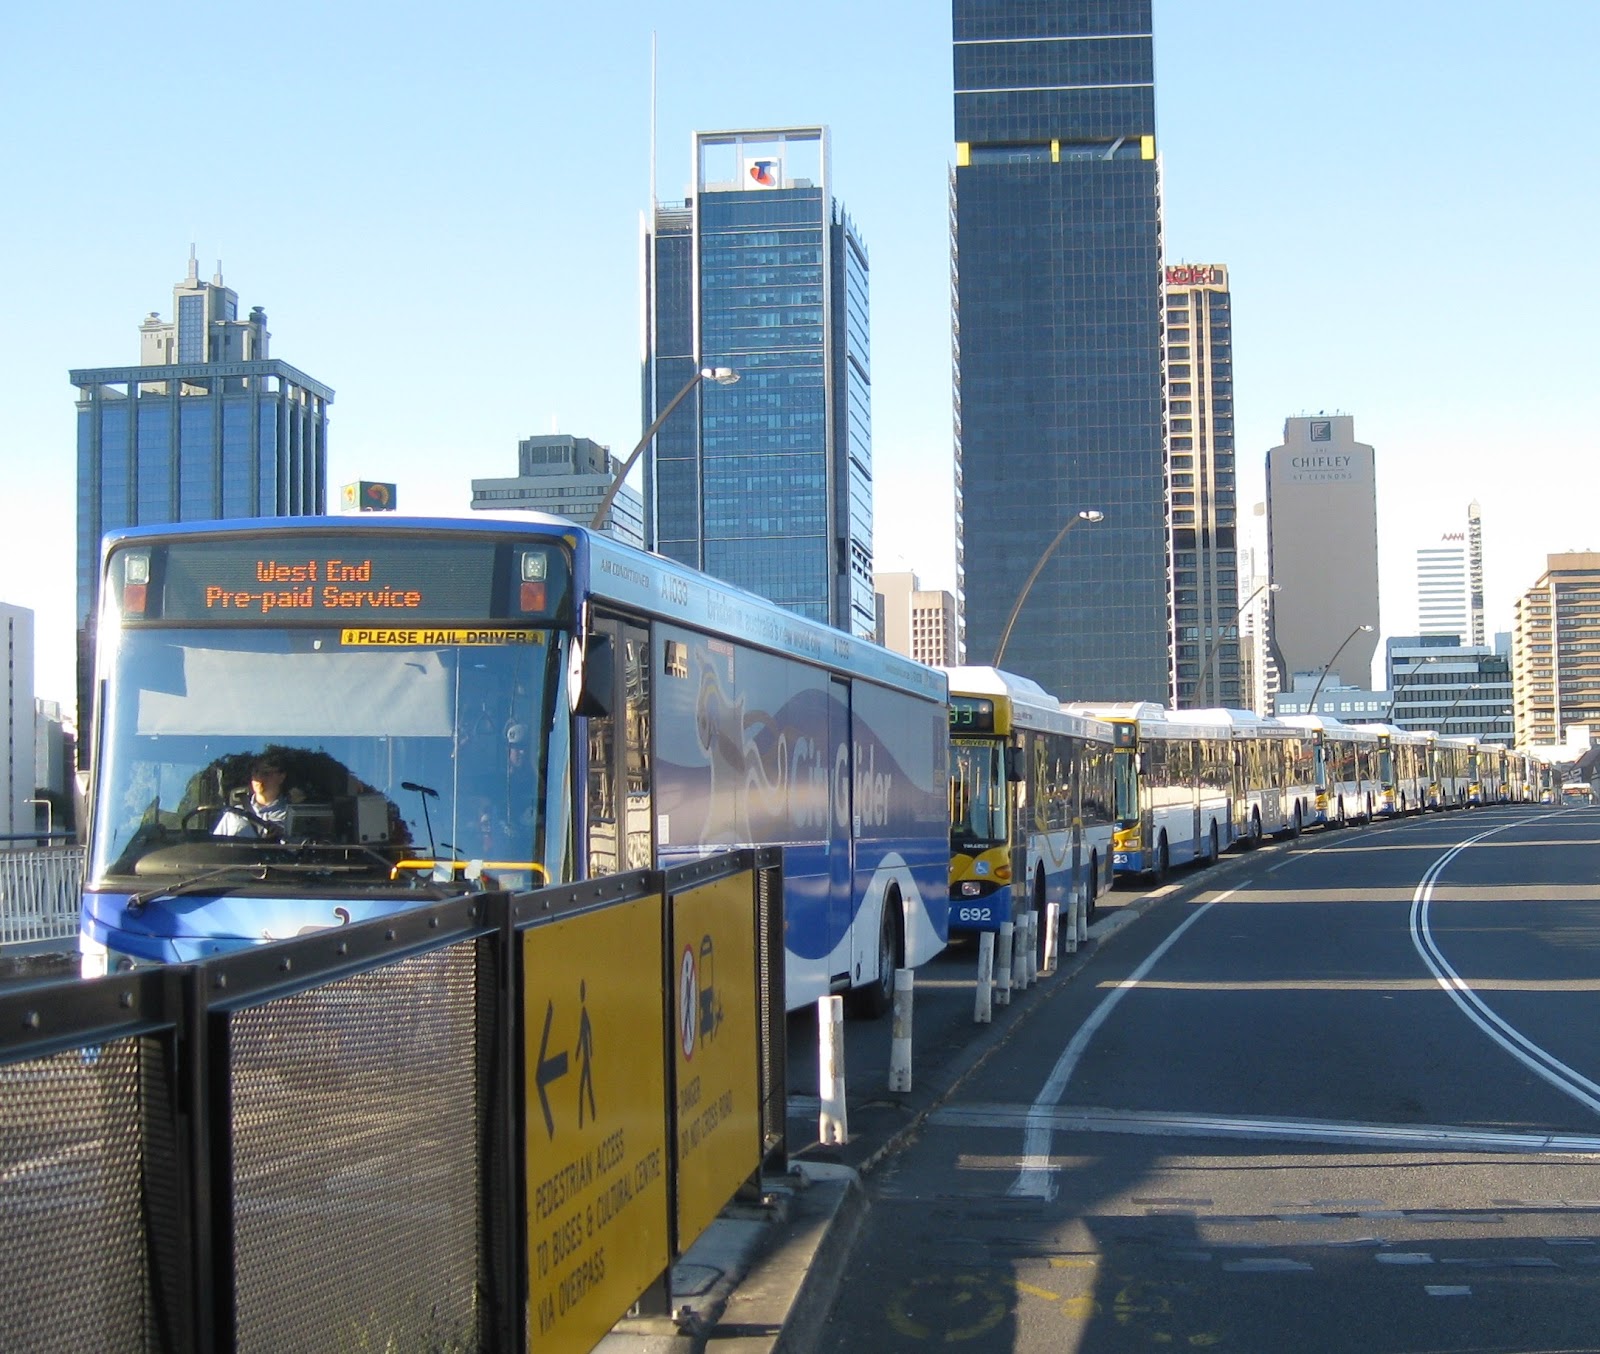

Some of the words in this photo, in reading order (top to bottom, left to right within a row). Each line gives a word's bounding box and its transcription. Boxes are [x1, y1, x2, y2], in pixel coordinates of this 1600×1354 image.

[1292, 456, 1351, 467] CHIFLEY
[256, 560, 318, 582] West
[326, 560, 371, 582] End
[205, 586, 314, 613] Pre-paid
[323, 586, 422, 608] Service
[358, 631, 418, 644] PLEASE
[423, 631, 460, 644] HAIL
[466, 631, 527, 644] DRIVER
[960, 907, 991, 921] 692
[536, 1151, 593, 1224] PEDESTRIAN
[597, 1127, 624, 1179] ACCESS
[536, 1240, 549, 1280] TO
[552, 1212, 583, 1267] BUSES
[586, 1205, 593, 1238] &
[597, 1171, 633, 1230] CULTURAL
[635, 1147, 661, 1194] CENTRE
[538, 1292, 555, 1336] VIA
[559, 1247, 605, 1316] OVERPASS
